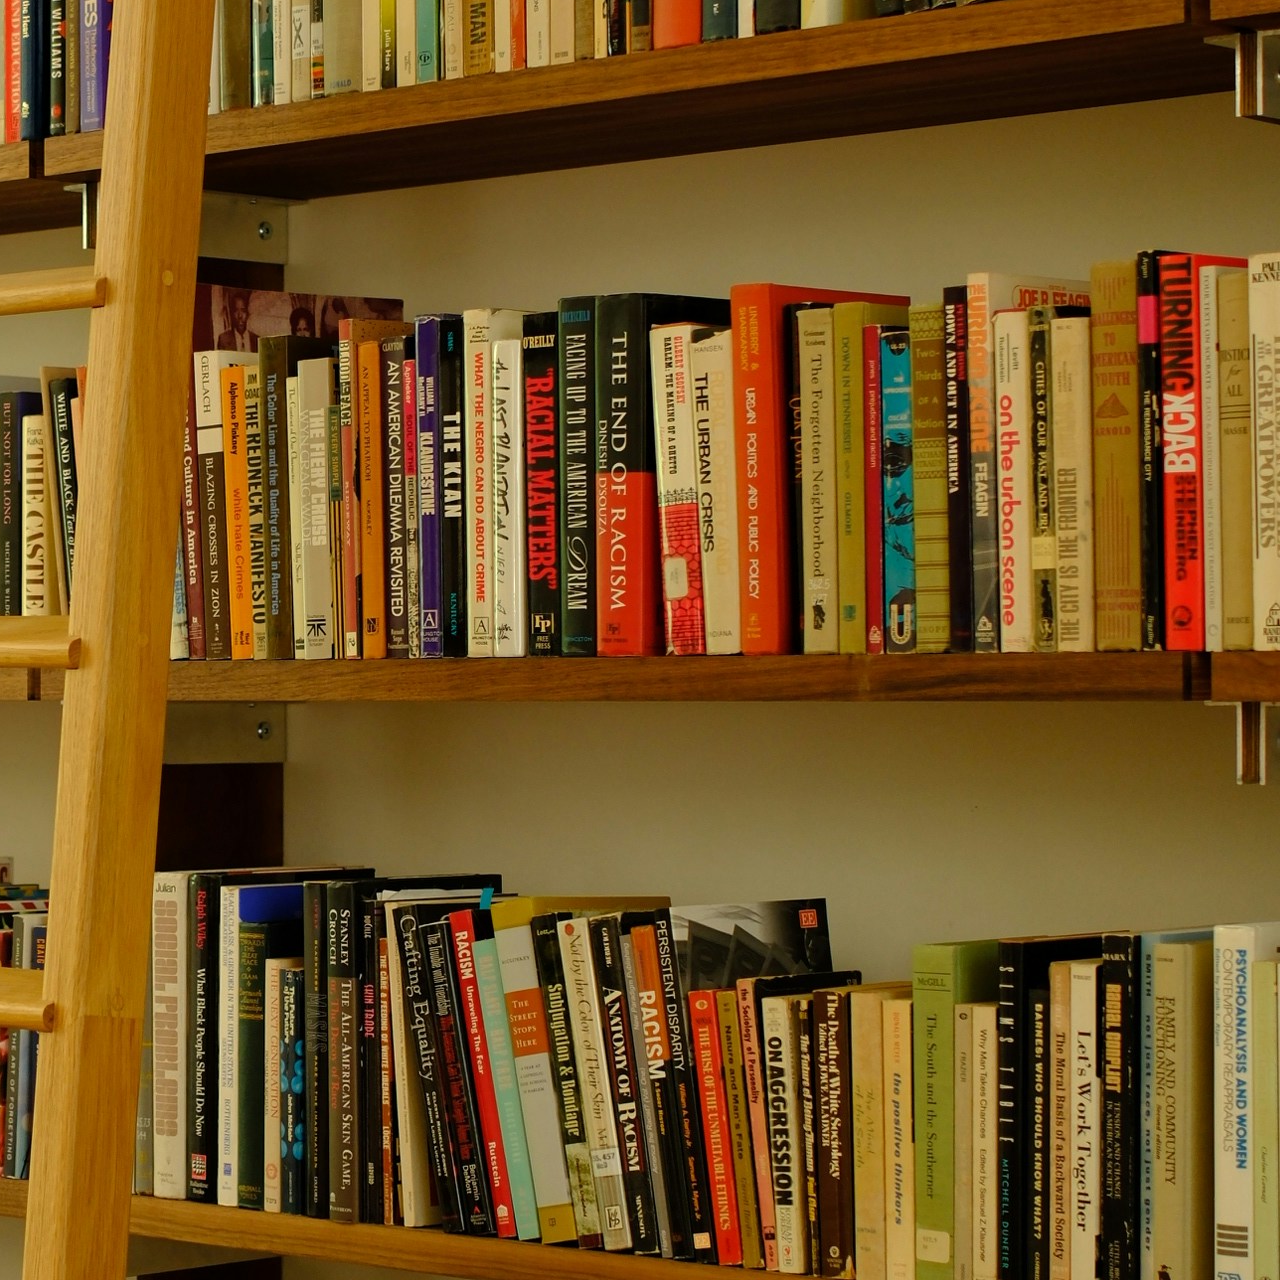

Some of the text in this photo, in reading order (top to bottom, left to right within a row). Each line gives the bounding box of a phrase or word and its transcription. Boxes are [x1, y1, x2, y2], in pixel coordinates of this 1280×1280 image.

[51, 8, 62, 79] WILLIAMS
[471, 2, 488, 45] MAN
[1160, 257, 1196, 473] TURNING BACK
[205, 458, 216, 510] BLAZING
[387, 361, 403, 618] AN AMERICAN DILEMMA REVISITED
[443, 412, 461, 519] THE KLAN
[475, 422, 484, 463] NEGRO
[598, 420, 607, 470] DINESH
[610, 332, 628, 610] THE END OF RACISM
[694, 372, 715, 553] THE URBAN CRISIS
[745, 388, 759, 599] URBAN POLITICS AND PUBLIC POLICY
[1000, 395, 1021, 625] on the urban scene
[26, 448, 44, 609] THE CASTLE
[208, 513, 218, 566] CROSSES
[211, 585, 220, 618] ZION
[476, 563, 485, 602] CRIME
[399, 915, 436, 1082] Crafting Equality
[454, 930, 474, 980] RACISM
[466, 985, 480, 1033] Unraveling
[656, 920, 685, 1071] PERSISTENT DISPARITY
[548, 984, 568, 1064] Subjugation
[561, 1078, 579, 1137] Bondage
[767, 1037, 794, 1206] ON AGGRESSION
[1073, 1032, 1091, 1232] Let's Work Together
[488, 1141, 500, 1188] Rutstein
